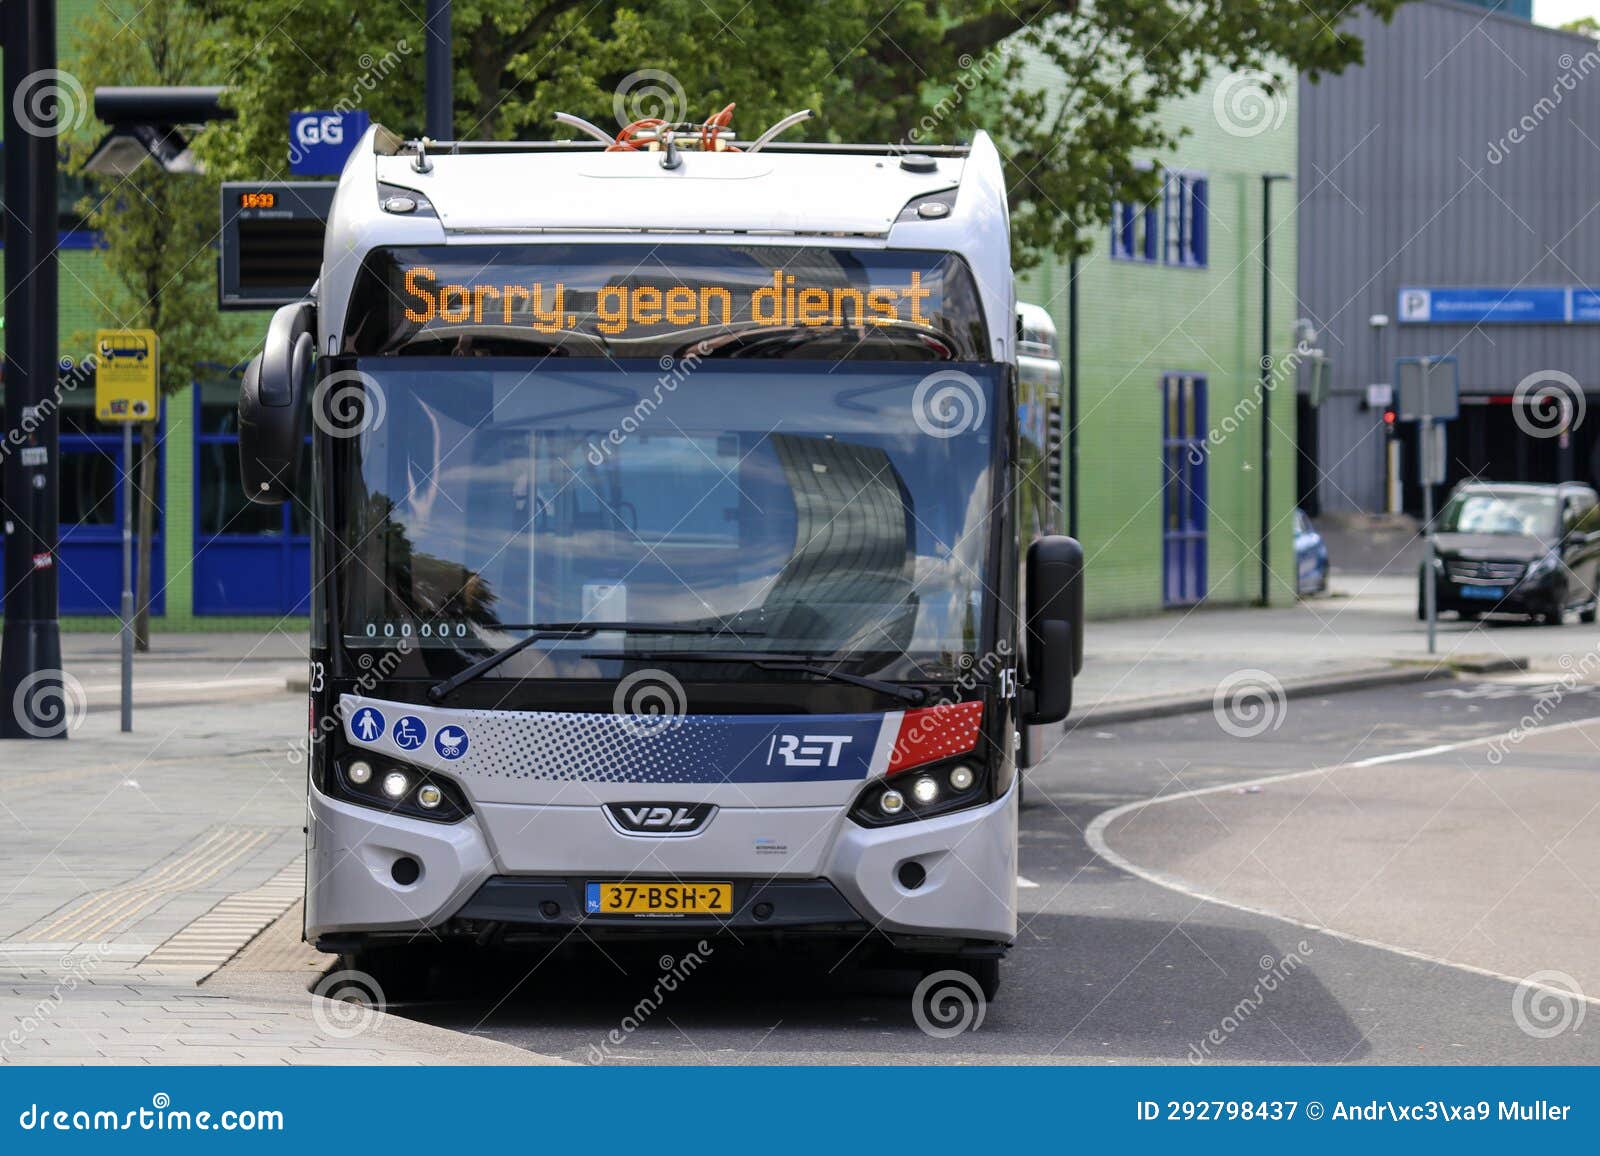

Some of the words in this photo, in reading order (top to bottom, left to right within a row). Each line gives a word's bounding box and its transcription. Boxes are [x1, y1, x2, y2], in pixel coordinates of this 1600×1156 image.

[296, 116, 344, 145] GG
[404, 267, 577, 334] Sorry,
[596, 286, 731, 334] geen
[752, 269, 930, 326] dienst
[767, 734, 853, 767] RET
[621, 807, 696, 827] VDL
[609, 887, 722, 909] 37-BSH-2
